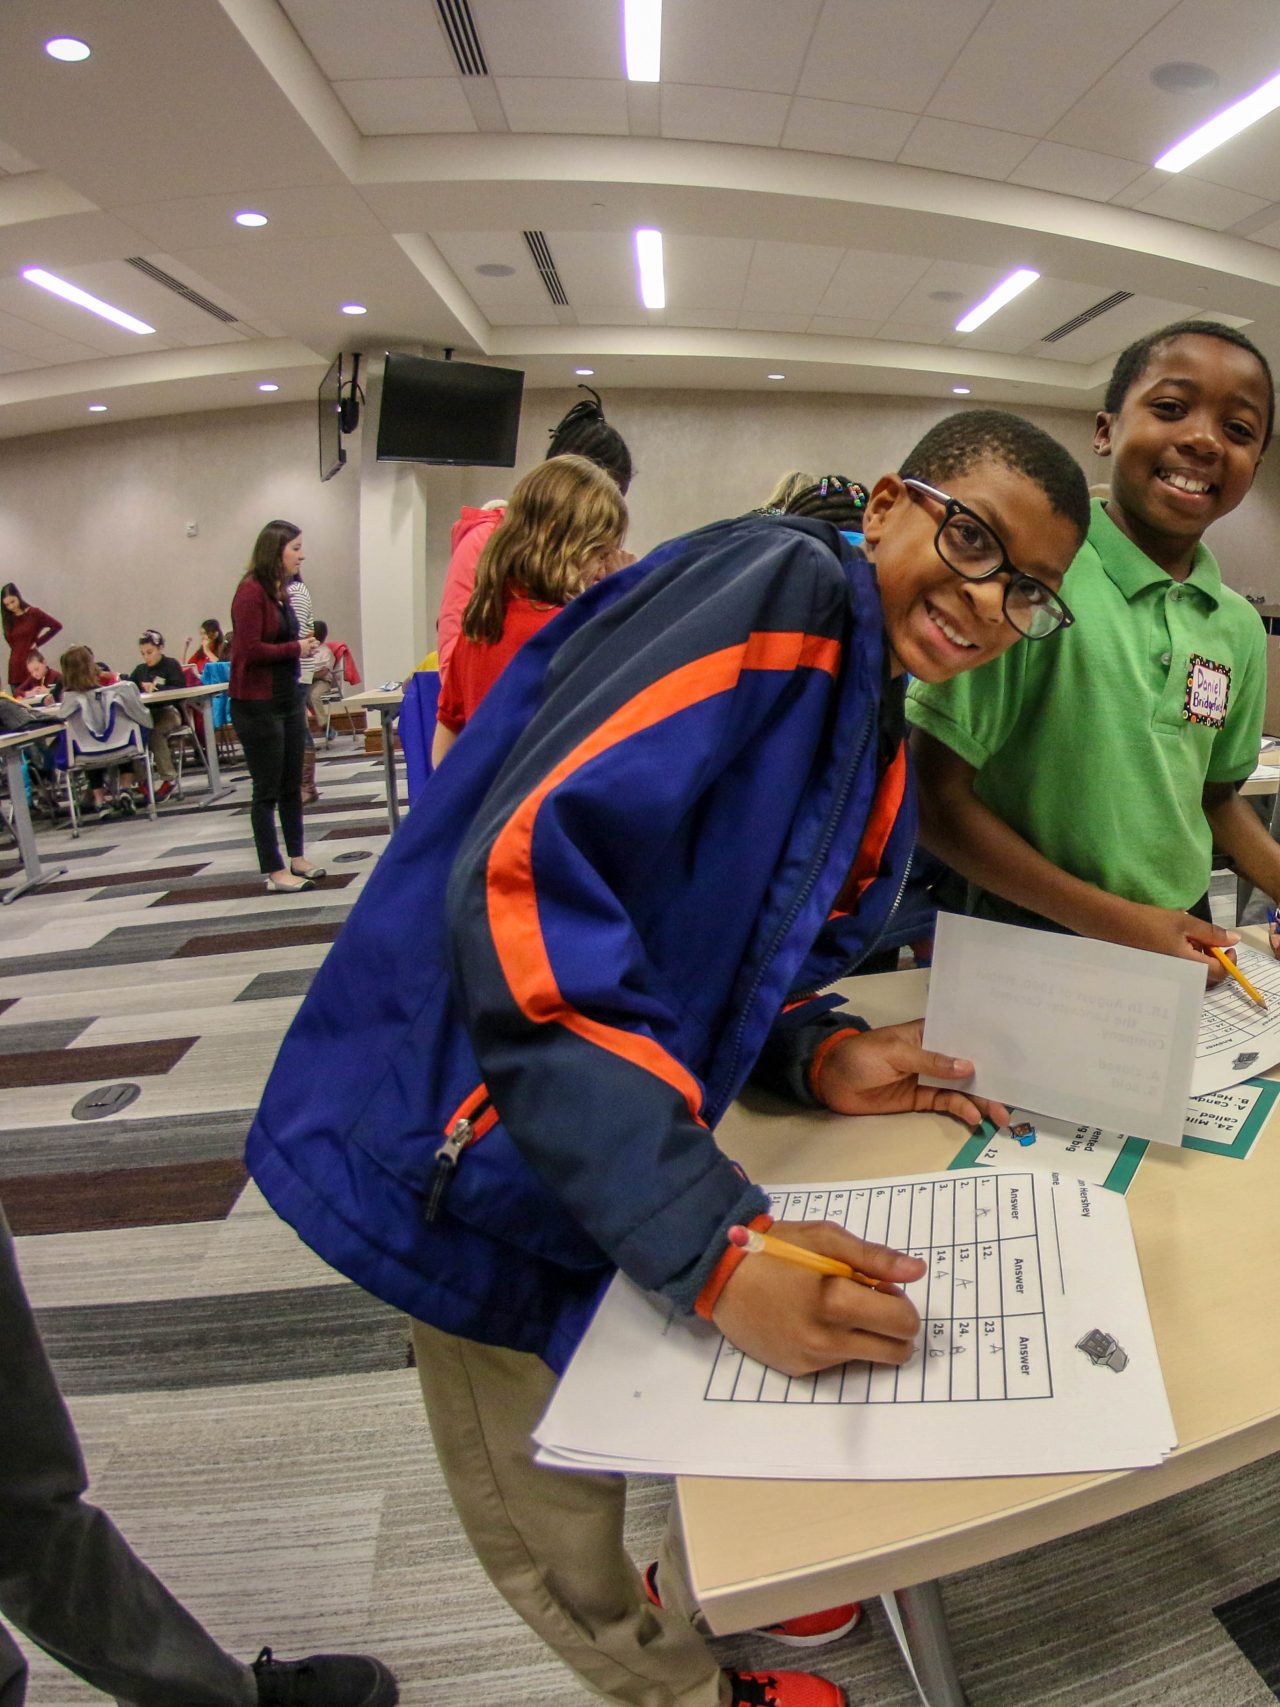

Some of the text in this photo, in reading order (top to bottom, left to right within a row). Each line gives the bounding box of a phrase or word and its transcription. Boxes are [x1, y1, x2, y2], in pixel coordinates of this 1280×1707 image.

[1197, 668, 1222, 696] Daniel
[1185, 1116, 1234, 1131] 24. Milt
[1200, 1112, 1238, 1123] called
[1065, 1141, 1083, 1152] big
[983, 1147, 999, 1160] 12
[939, 1183, 949, 1192] 3.
[960, 1181, 969, 1189] 2.
[981, 1179, 991, 1187] 1.
[855, 1192, 865, 1200] 7.
[876, 1190, 886, 1198] 6.
[897, 1188, 907, 1196] 5.
[918, 1186, 927, 1194] 4.
[792, 1195, 802, 1207] 10.
[814, 1194, 823, 1202] 9.
[835, 1193, 844, 1201] 8.
[1080, 1187, 1091, 1218] Hershey
[1010, 1188, 1020, 1220] Answer
[936, 1250, 946, 1265] 14.
[960, 1248, 970, 1263] 13.
[982, 1244, 993, 1260] 12.
[1014, 1258, 1024, 1294] Answer
[933, 1323, 944, 1339] 25.
[959, 1322, 970, 1338] 24.
[984, 1321, 995, 1337] 23.
[1019, 1336, 1030, 1376] Answer
